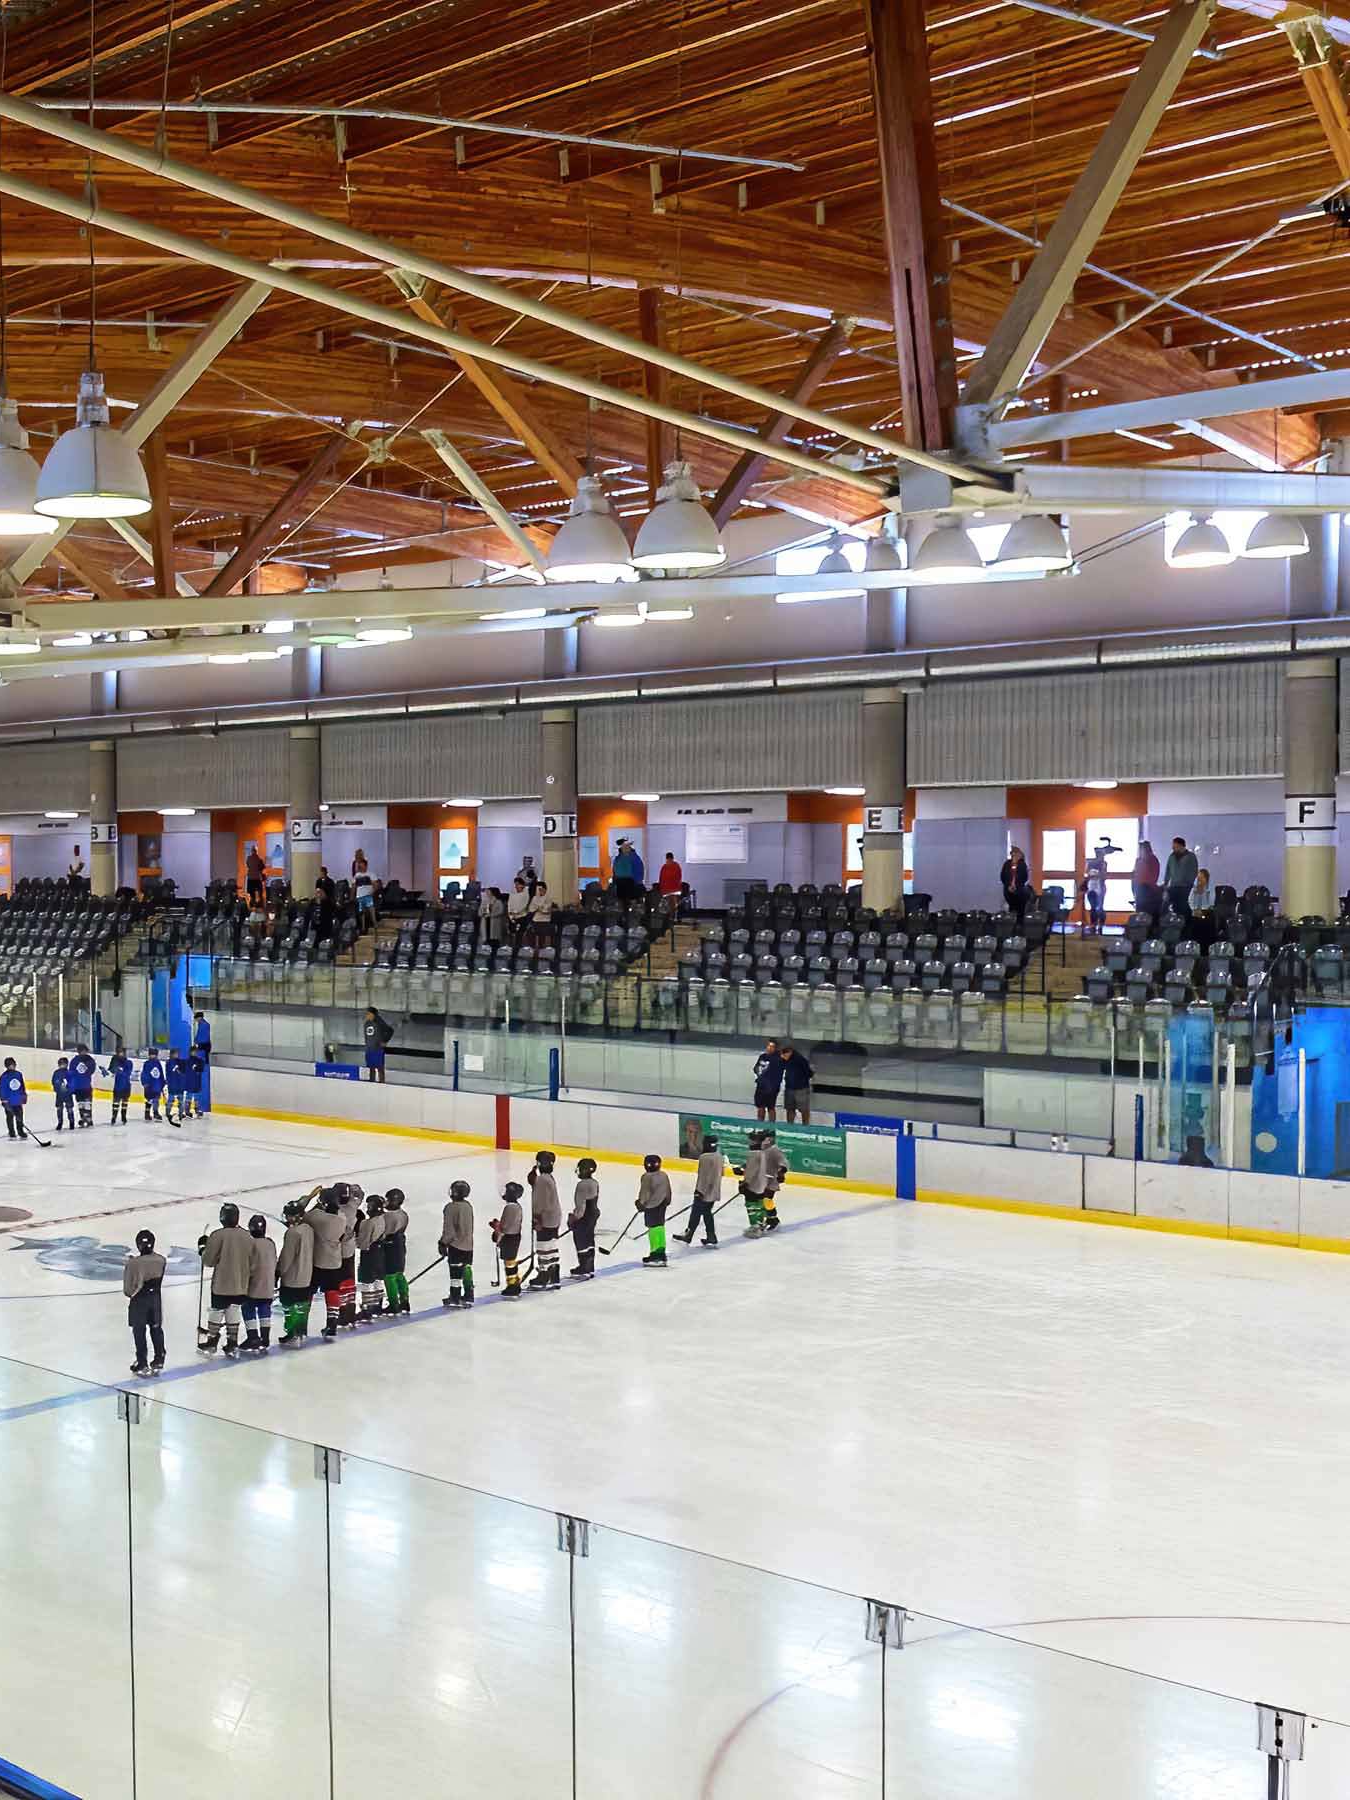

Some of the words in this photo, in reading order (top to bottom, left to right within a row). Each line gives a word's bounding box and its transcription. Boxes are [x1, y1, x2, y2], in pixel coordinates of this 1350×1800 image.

[868, 809, 882, 829] E
[1299, 801, 1316, 823] F
[91, 826, 98, 840] B
[292, 822, 301, 837] C
[545, 816, 556, 833] D
